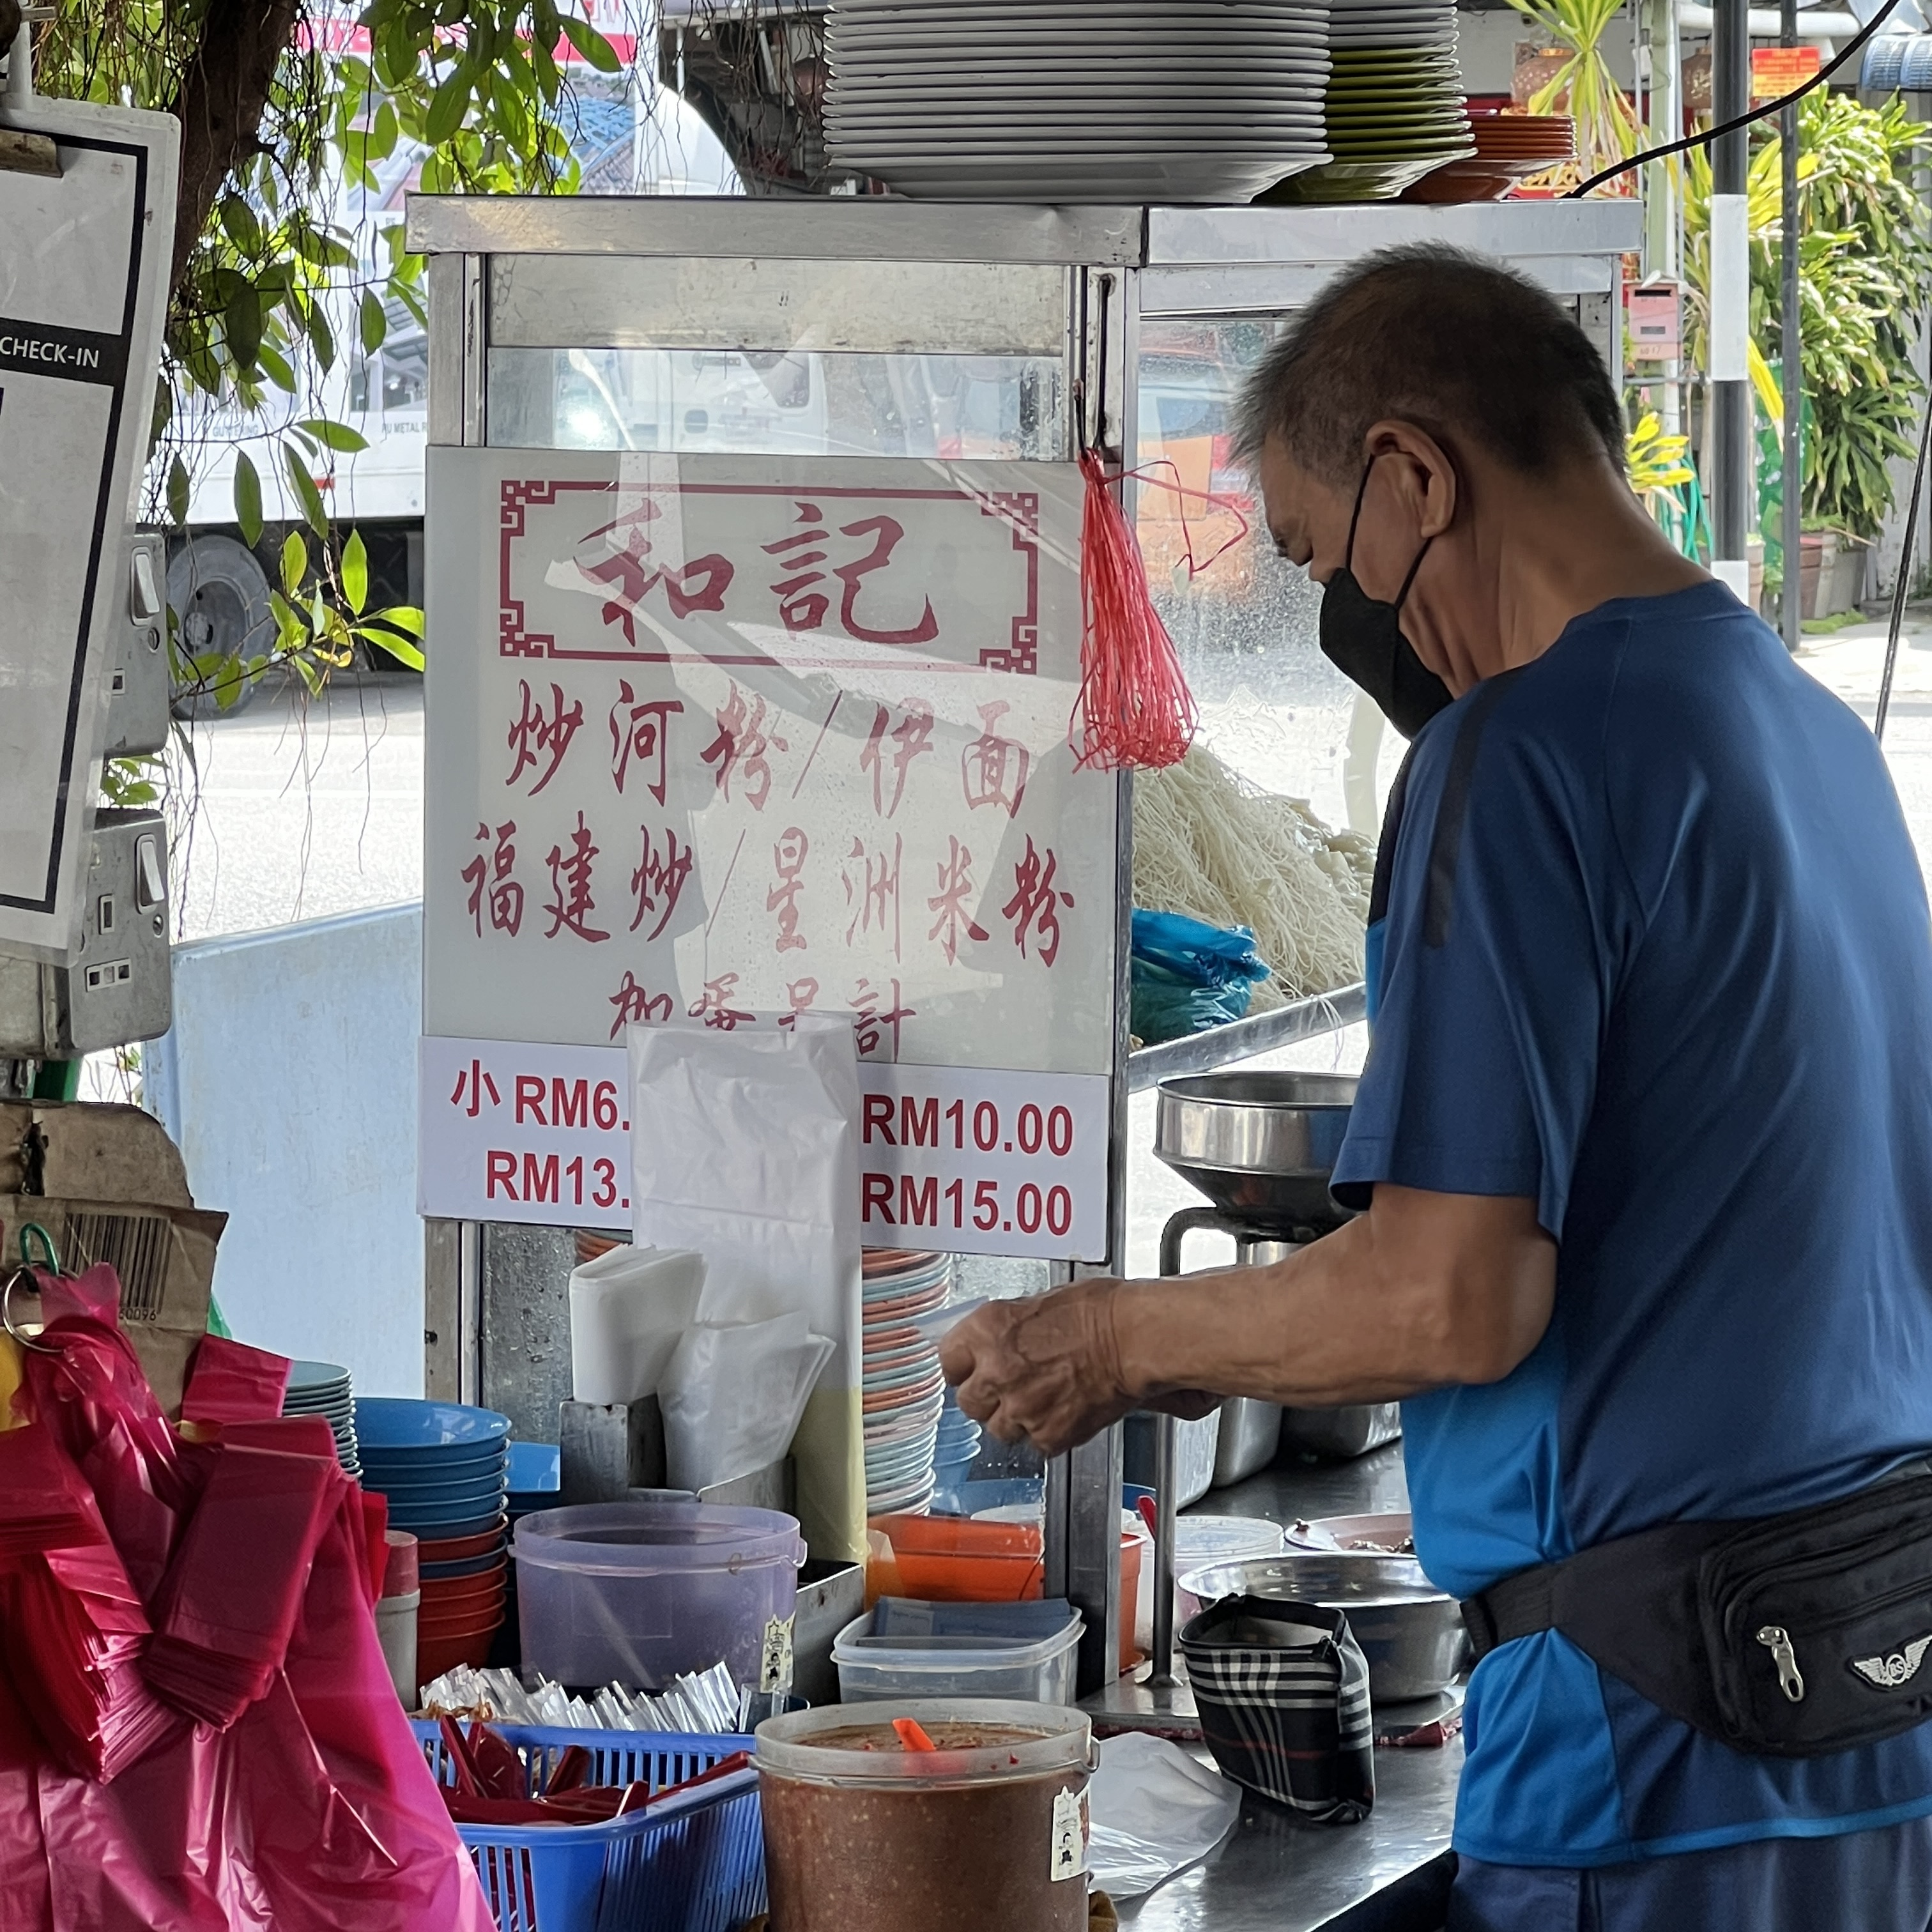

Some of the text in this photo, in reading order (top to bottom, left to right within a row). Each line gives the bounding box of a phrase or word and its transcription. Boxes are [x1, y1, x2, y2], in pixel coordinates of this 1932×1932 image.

[0, 336, 99, 368] CHECK-IN
[572, 498, 939, 647] 和記
[450, 1059, 501, 1117] 小
[862, 1093, 1073, 1156] RM10.00
[862, 1172, 1072, 1236] RM15.00
